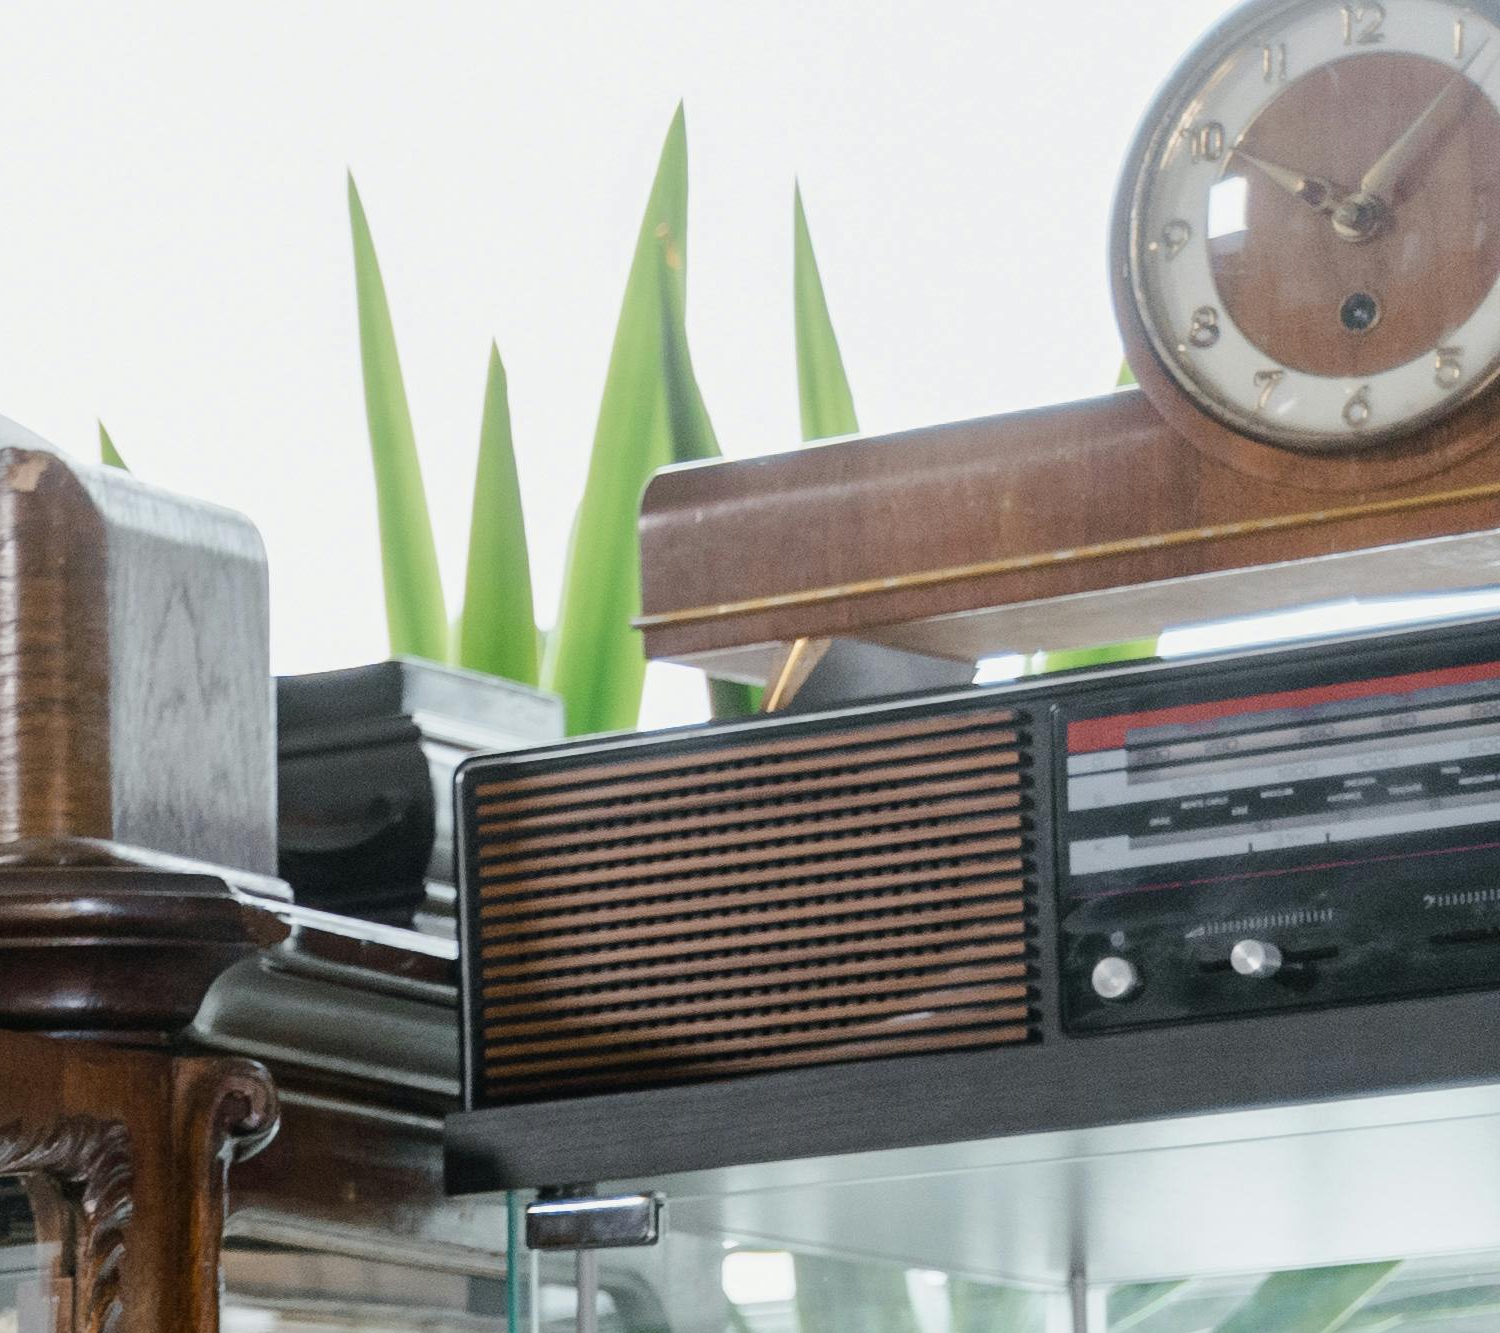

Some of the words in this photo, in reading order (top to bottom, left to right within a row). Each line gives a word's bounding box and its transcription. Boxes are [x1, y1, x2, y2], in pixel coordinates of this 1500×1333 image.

[1340, 3, 1387, 47] 12
[1454, 20, 1465, 59] 1
[1262, 43, 1288, 83] 11
[1191, 121, 1224, 163] 10
[1188, 305, 1220, 349] 8
[1434, 346, 1462, 390] 5
[1253, 369, 1284, 411] 7
[1342, 384, 1370, 428] 6
